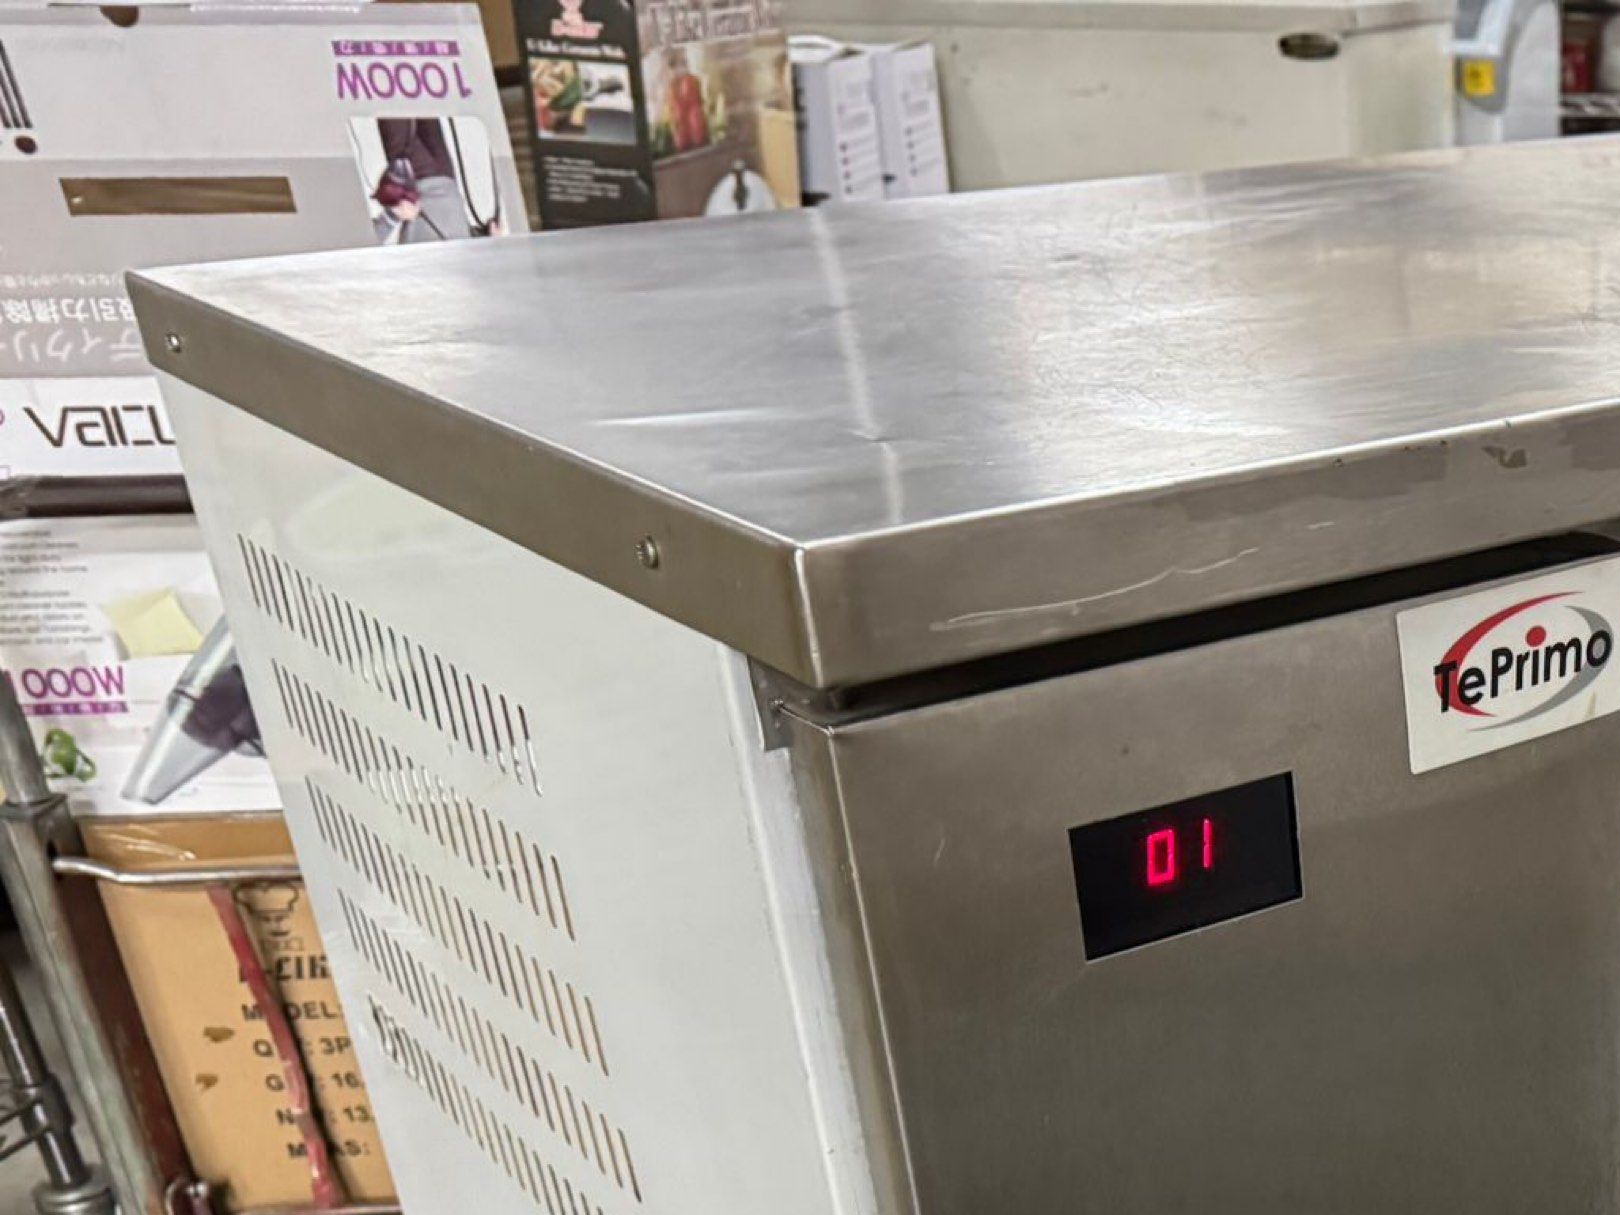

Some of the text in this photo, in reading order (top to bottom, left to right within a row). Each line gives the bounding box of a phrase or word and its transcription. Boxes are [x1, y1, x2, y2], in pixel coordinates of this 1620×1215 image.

[337, 61, 472, 100] 1000W
[0, 327, 143, 363] ディクリ
[6, 664, 124, 698] 000W
[1433, 626, 1612, 713] TePrimo
[1146, 818, 1213, 887] 01
[242, 1001, 344, 1021] MDEL:
[319, 1036, 352, 1055] 3P
